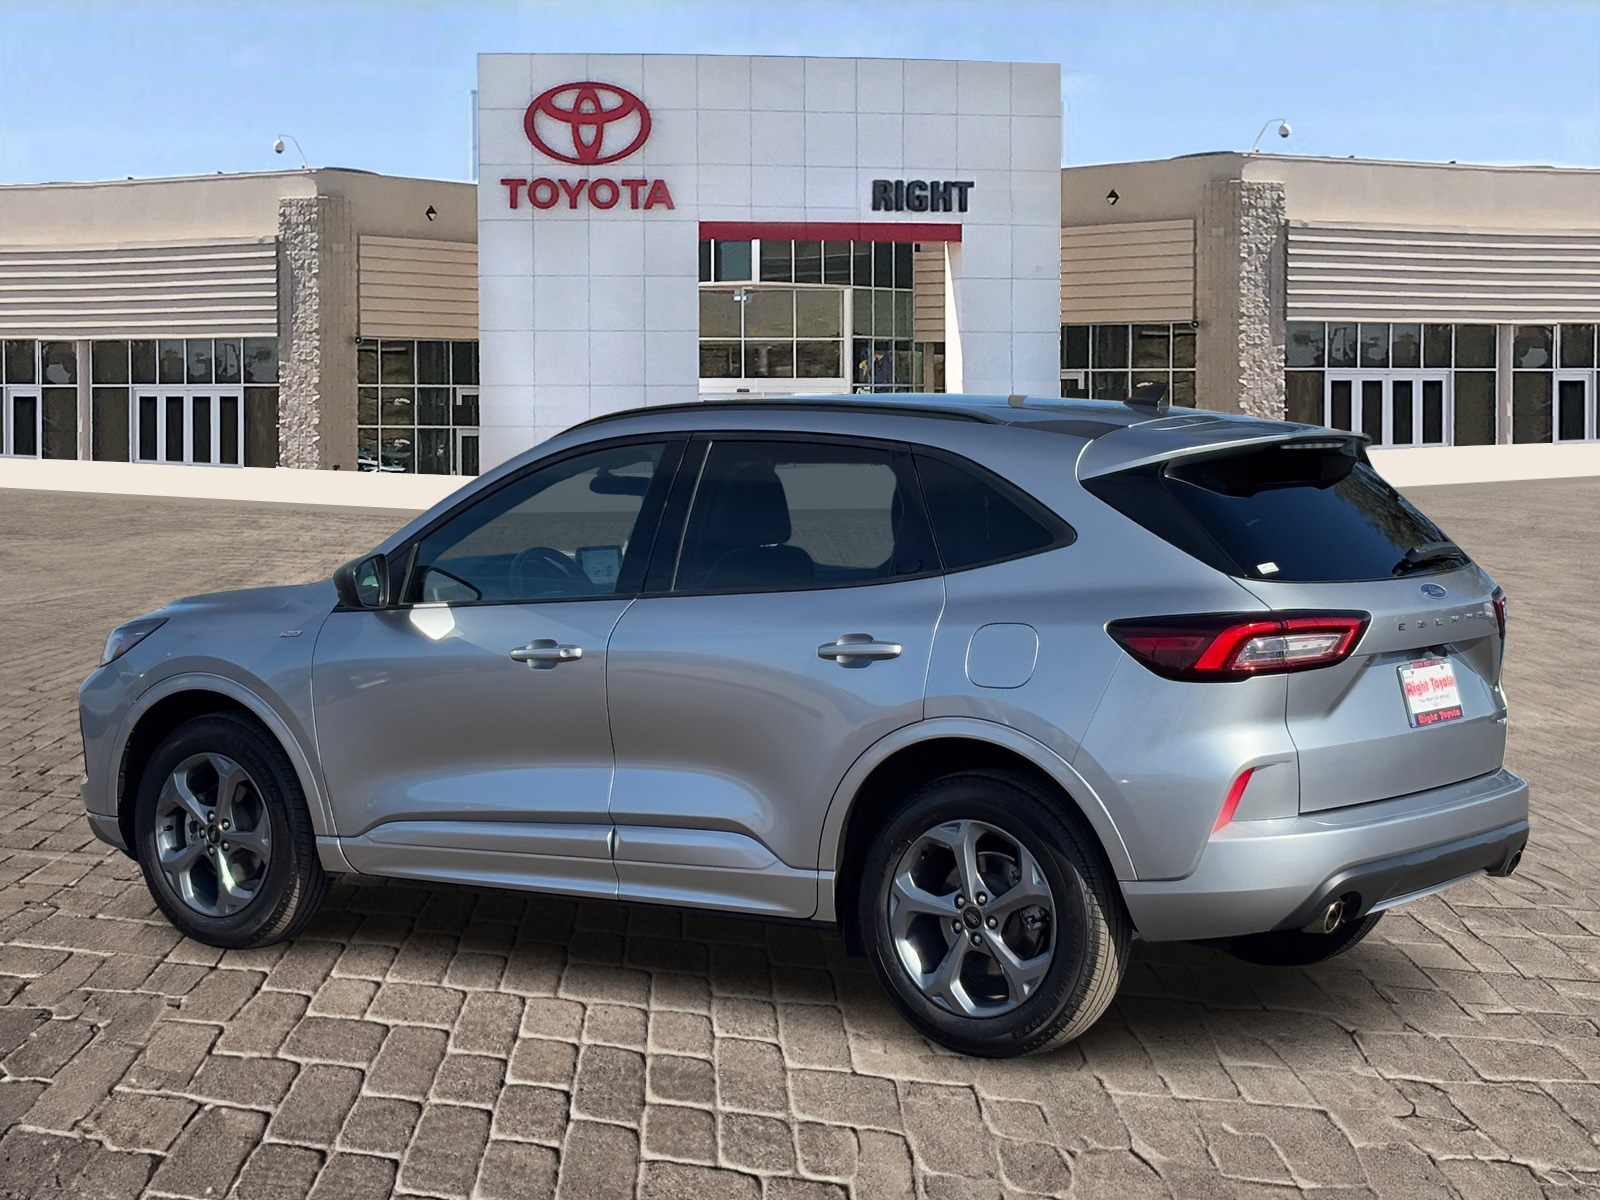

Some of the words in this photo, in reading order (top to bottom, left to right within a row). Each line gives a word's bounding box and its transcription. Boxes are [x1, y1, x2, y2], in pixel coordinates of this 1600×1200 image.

[500, 178, 675, 209] TOYOTA
[872, 179, 975, 212] RIGHT
[1405, 679, 1429, 696] Right
[1430, 675, 1455, 692] Toyota
[1418, 713, 1438, 725] Right
[1439, 709, 1461, 720] Toyota
